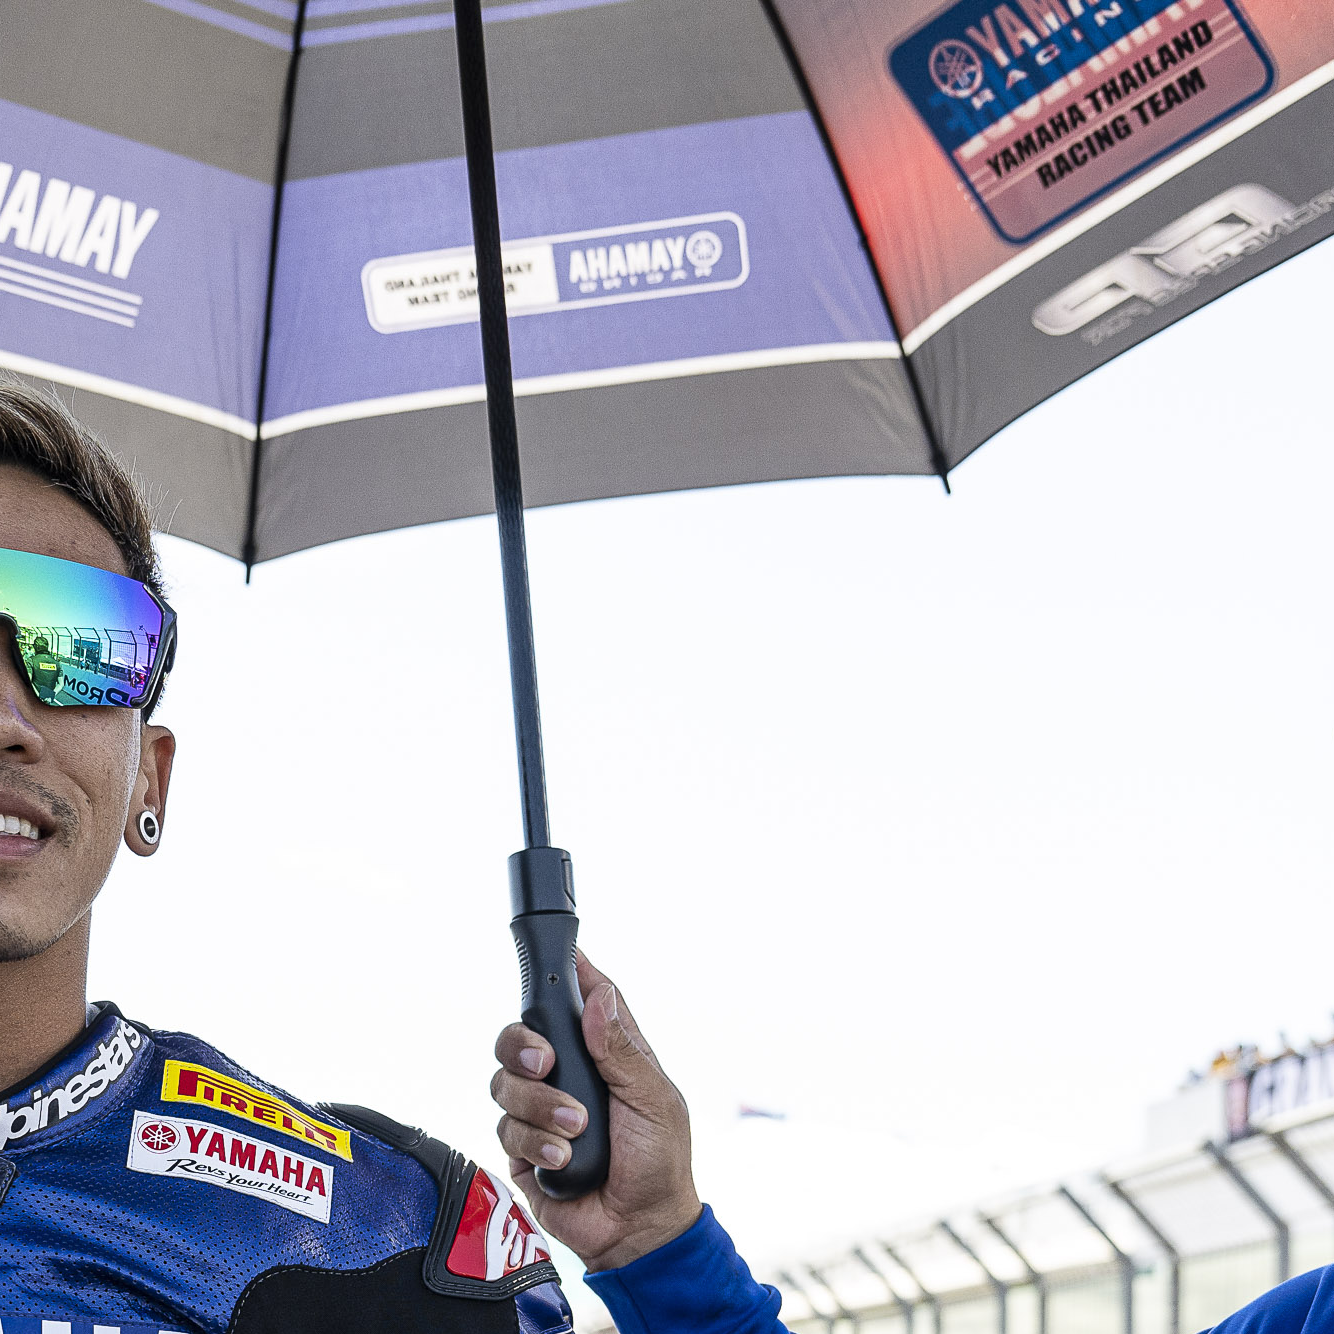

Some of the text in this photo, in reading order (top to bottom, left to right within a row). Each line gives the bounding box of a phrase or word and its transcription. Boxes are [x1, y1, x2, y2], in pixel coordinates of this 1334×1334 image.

[985, 18, 1215, 179] YAMAHA THAILAND
[1035, 66, 1208, 190] RACING TEAM
[178, 1069, 337, 1151] PIRELLI
[165, 1158, 312, 1202] Revs Your Heart
[185, 1125, 327, 1197] YAMAHA
